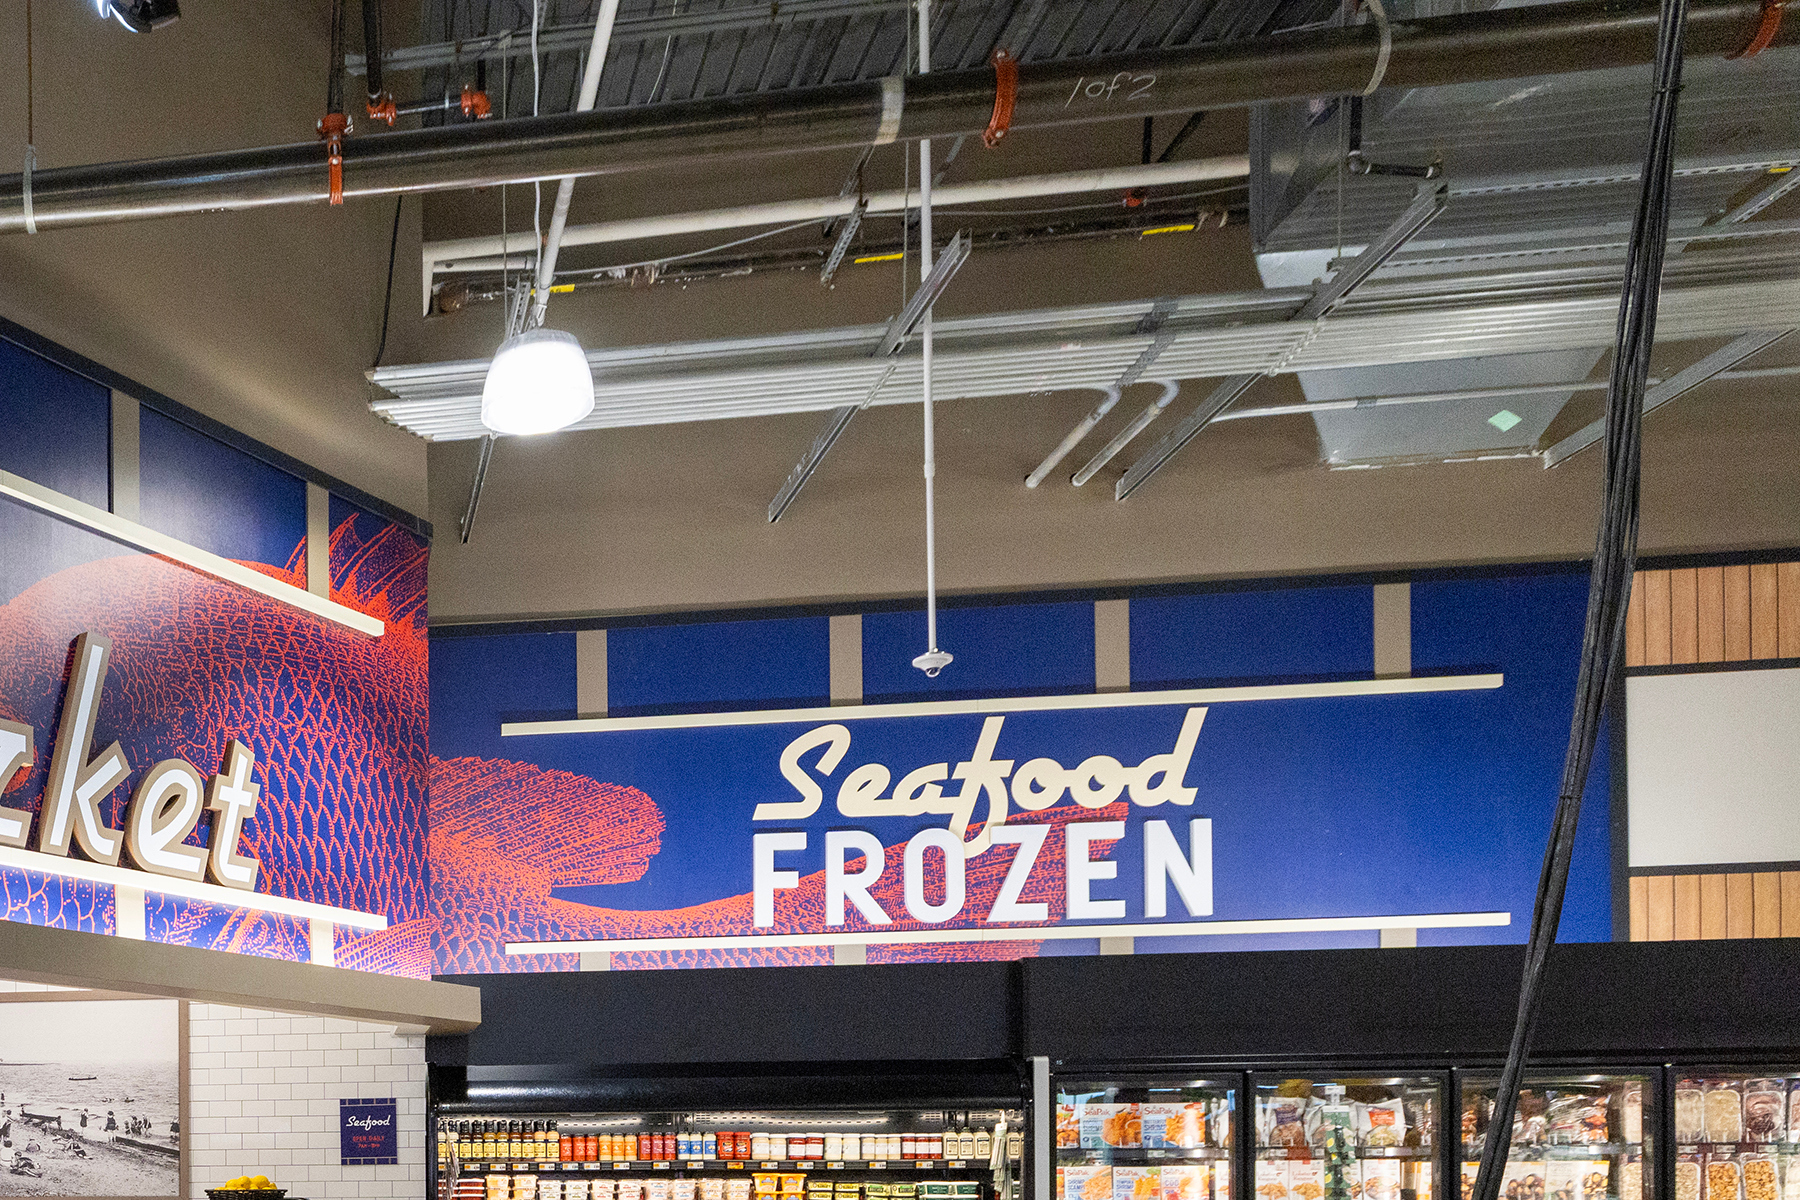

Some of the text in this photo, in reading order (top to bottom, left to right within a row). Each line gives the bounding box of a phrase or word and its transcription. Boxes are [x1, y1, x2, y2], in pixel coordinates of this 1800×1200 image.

[1085, 72, 1131, 100] of
[1128, 74, 1157, 99] 2
[752, 707, 1209, 859] Seafood
[752, 818, 1213, 928] FROZEN
[346, 1115, 391, 1131] Seafood
[1144, 1107, 1173, 1115] SeaPak
